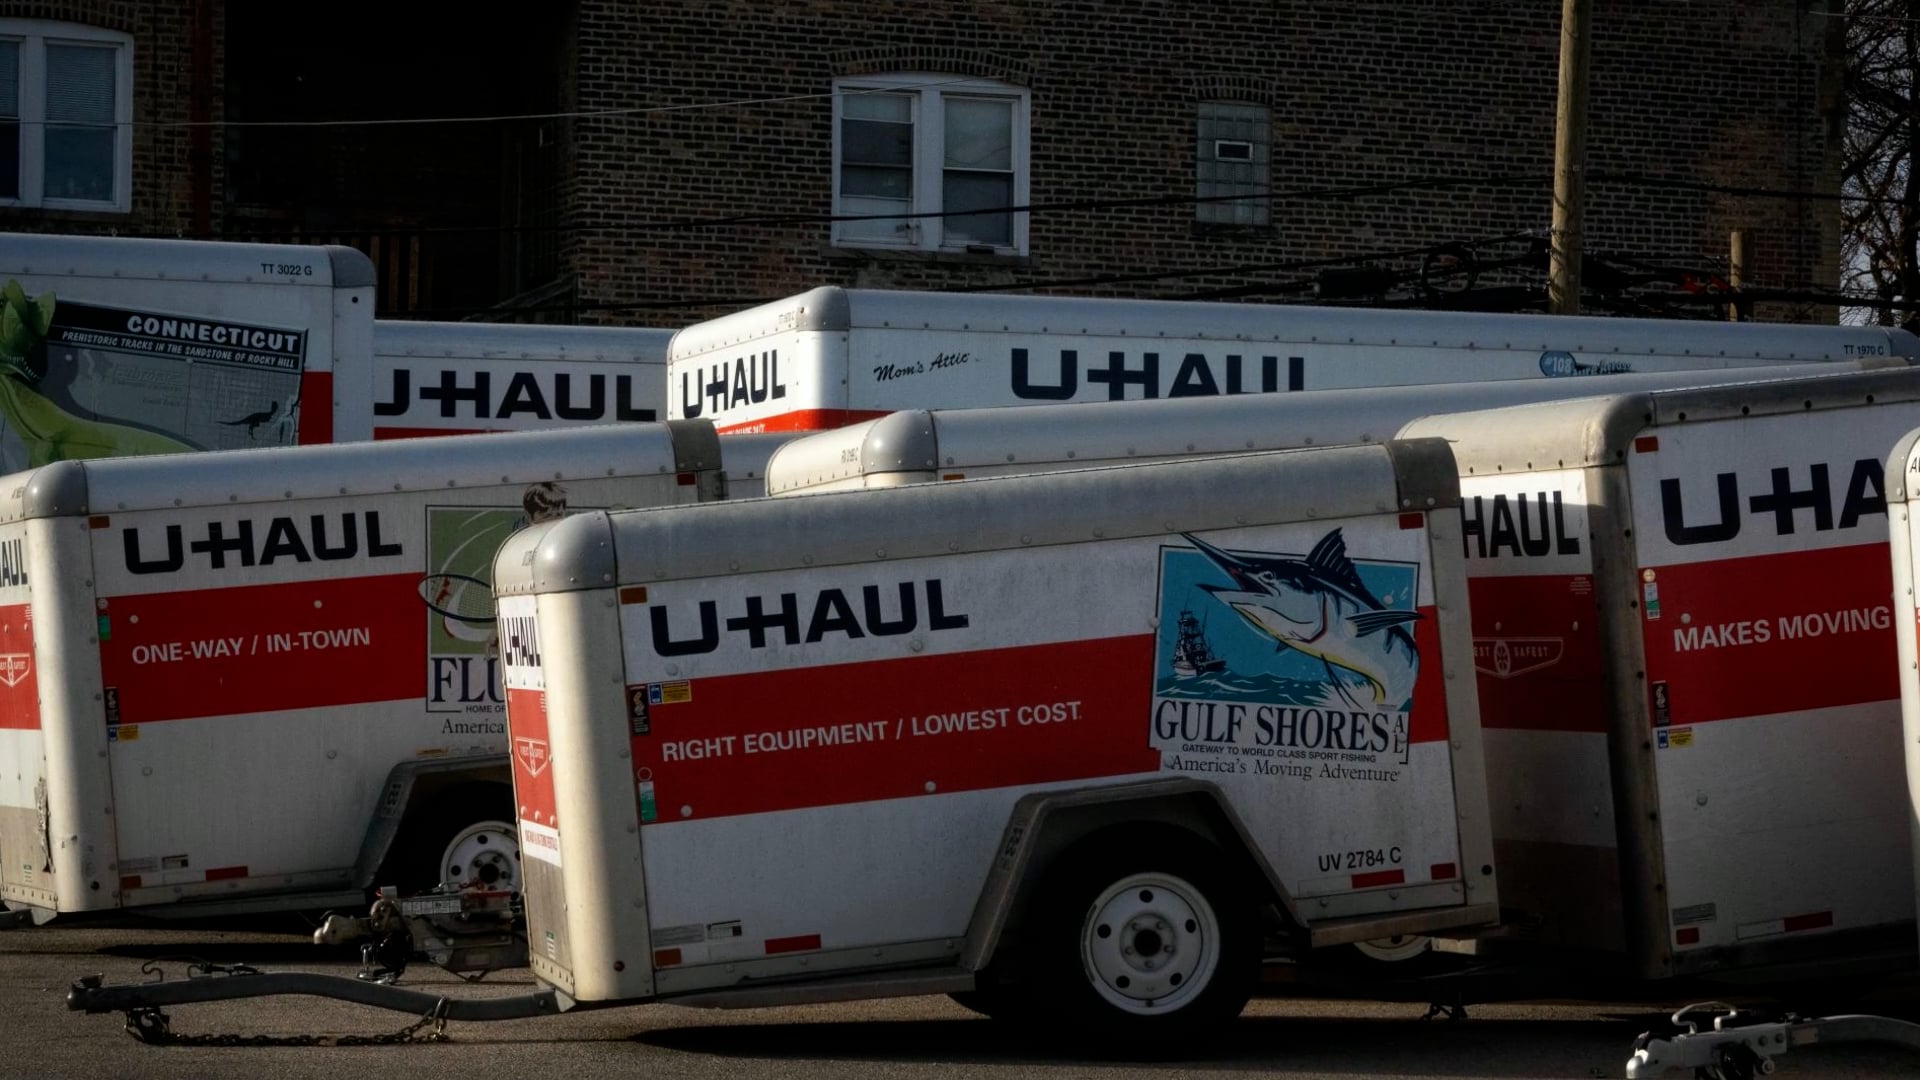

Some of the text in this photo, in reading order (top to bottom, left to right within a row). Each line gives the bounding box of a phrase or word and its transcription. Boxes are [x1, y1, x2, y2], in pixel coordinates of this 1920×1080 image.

[261, 263, 312, 275] TT 3022 G
[62, 331, 294, 368] PREHISTORIC TRACKS IN THE SANDSTONE OF ROCKY HILL
[127, 315, 298, 351] CONNECTICUT
[683, 349, 785, 418] U-HAUL
[873, 353, 970, 381] Mom's Attic
[1660, 459, 1889, 545] U-HA
[1460, 490, 1580, 558] HAUL
[123, 511, 403, 575] U-HAUL
[650, 579, 969, 657] U-HAUL
[1674, 614, 1771, 652] MAKES
[1778, 605, 1891, 641] MOVING
[132, 637, 243, 665] ONE-WAY
[266, 627, 371, 654] IN-TOWN
[442, 719, 505, 734] America
[466, 705, 493, 713] HOME
[1155, 700, 1389, 752] GULF SHORES
[662, 736, 737, 761] RIGHT
[743, 720, 888, 754] EQUIPMENT
[912, 708, 1010, 736] LOWEST
[1017, 701, 1081, 725] COST
[1171, 755, 1397, 782] America's Moving Adventure
[1182, 744, 1376, 763] GATEWAY TO WORLD CLASS SPORT FISHING
[1319, 847, 1402, 872] UV 2784 C
